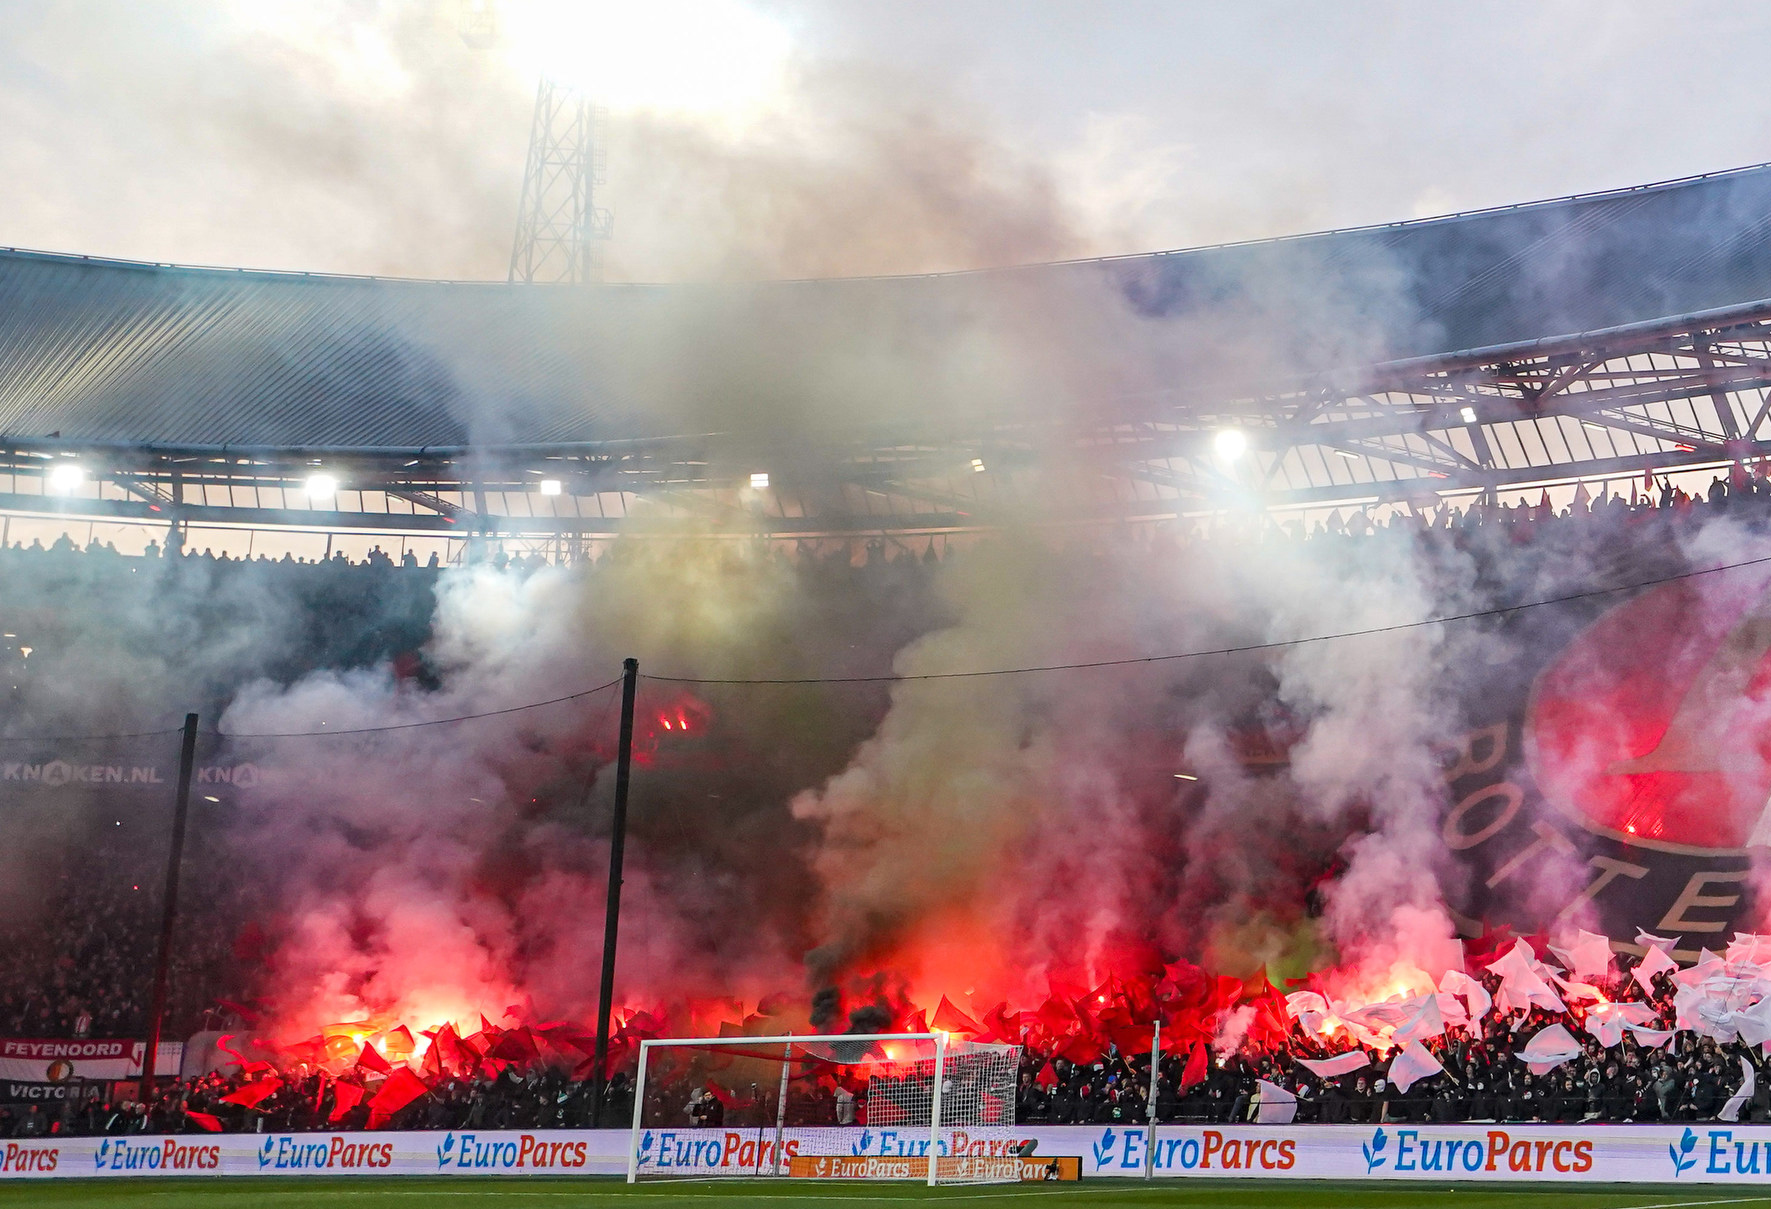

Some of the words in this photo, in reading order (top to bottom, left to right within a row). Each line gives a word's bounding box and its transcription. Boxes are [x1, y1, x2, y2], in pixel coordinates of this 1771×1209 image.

[3, 760, 164, 786] KNAKEN.NL
[4, 1041, 122, 1057] FEYENOORD
[10, 1083, 100, 1099] VICTORIA
[110, 1139, 220, 1170] EuroParcs
[274, 1136, 393, 1168] EuroParcs
[457, 1133, 587, 1168] EuroParcs
[657, 1132, 800, 1167] EuroParcs
[1120, 1129, 1296, 1170] EuroParcs
[1394, 1130, 1593, 1173] EuroParcs
[830, 1157, 910, 1178] EuroParcs
